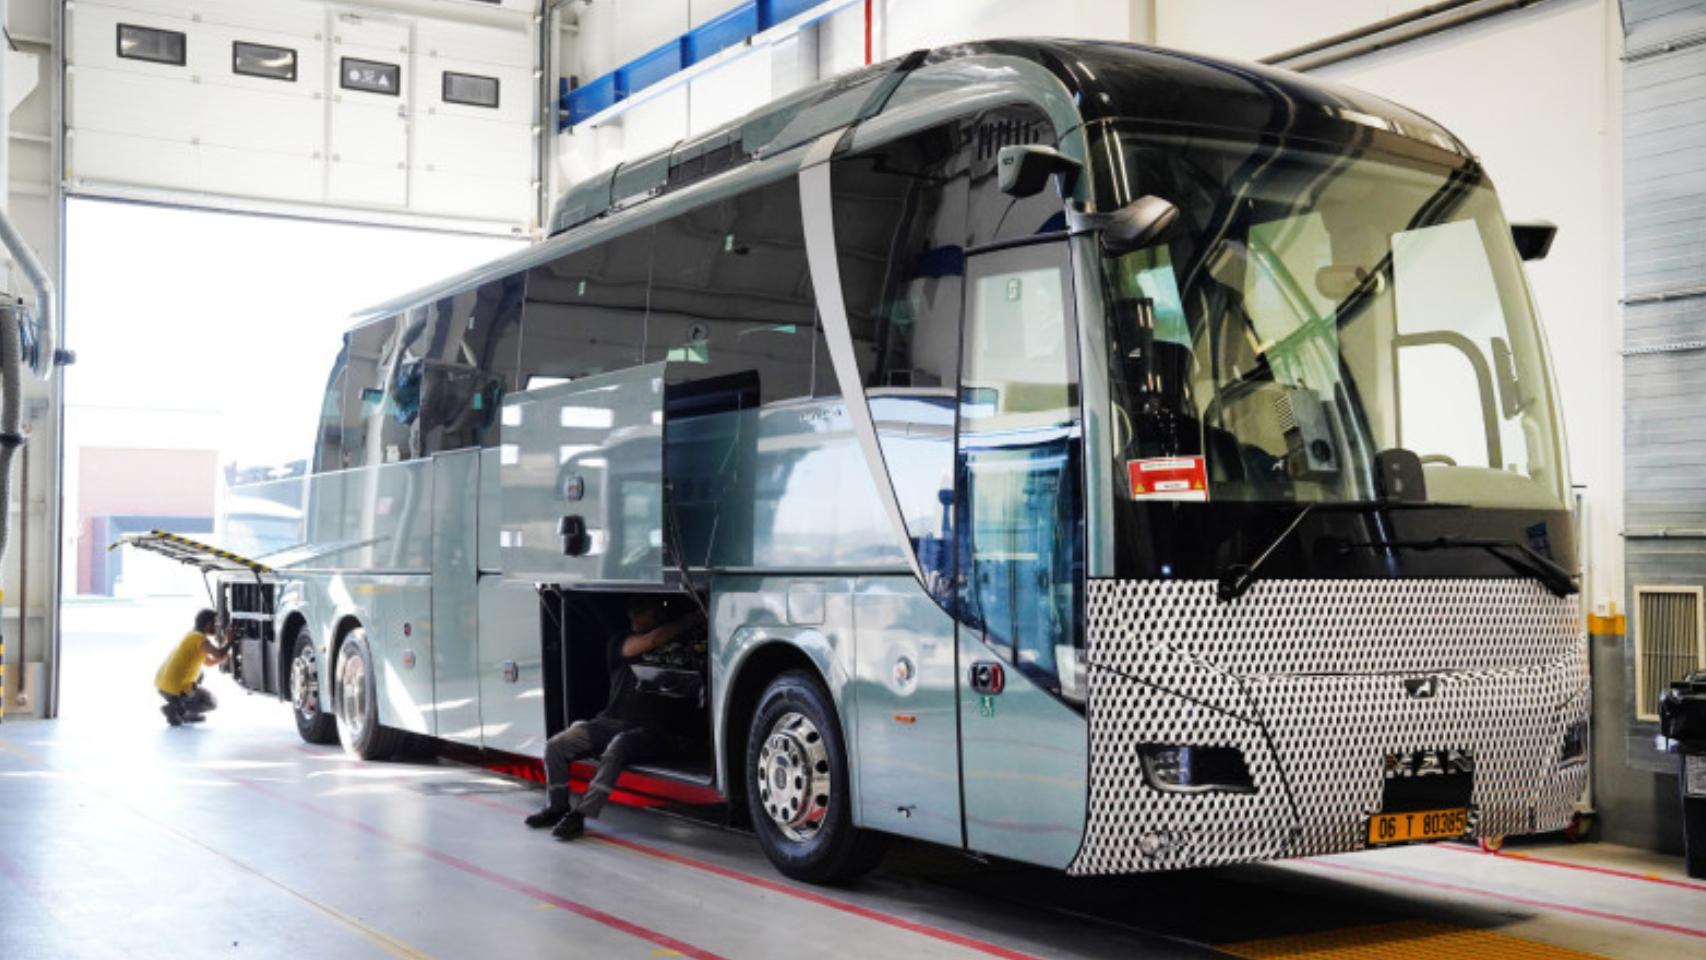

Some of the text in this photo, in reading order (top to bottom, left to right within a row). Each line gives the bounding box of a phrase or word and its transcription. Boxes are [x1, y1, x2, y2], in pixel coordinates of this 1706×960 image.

[1379, 810, 1465, 839] 06 T 80385
